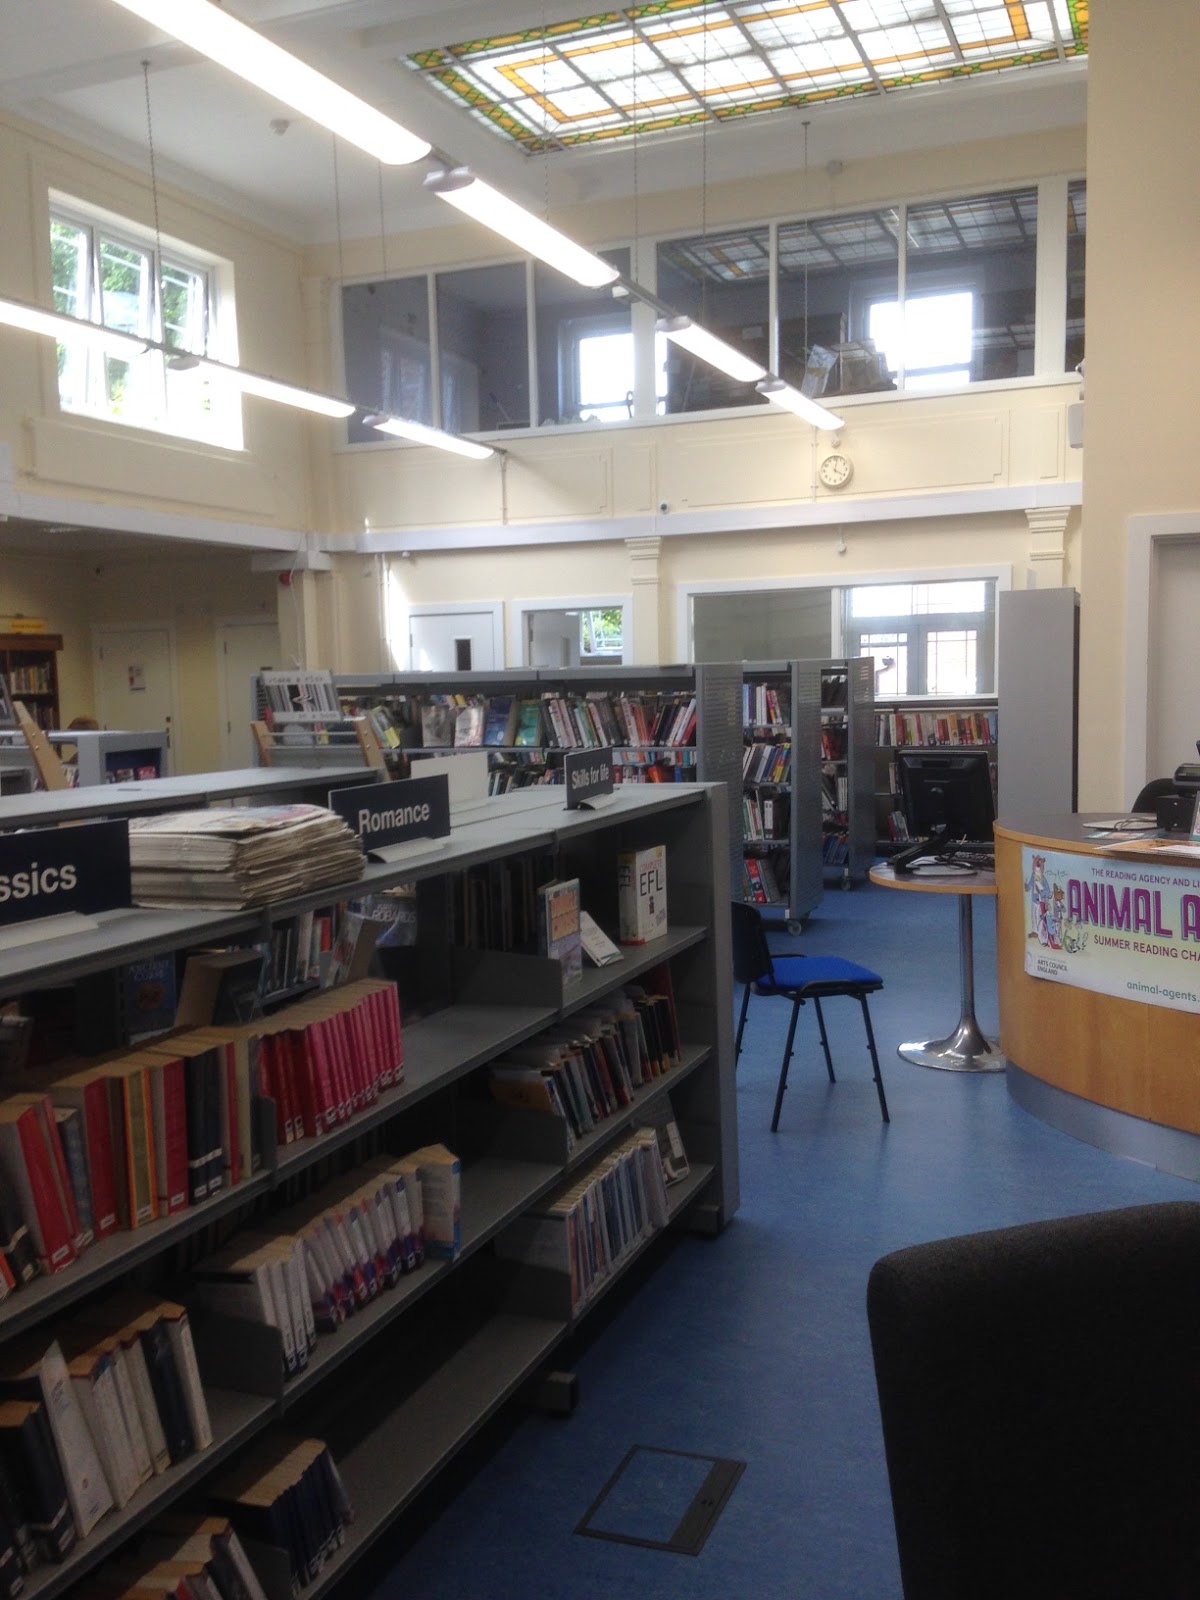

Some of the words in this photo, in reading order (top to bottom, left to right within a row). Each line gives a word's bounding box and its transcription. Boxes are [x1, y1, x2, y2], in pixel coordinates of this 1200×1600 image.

[571, 768, 590, 790] Skills
[590, 766, 599, 784] for
[600, 763, 610, 781] life
[358, 803, 430, 835] Romance
[639, 869, 664, 897] EFL
[1091, 867, 1104, 877] THE
[1105, 869, 1137, 881] READING
[1138, 874, 1171, 885] AGENCY
[1172, 878, 1190, 887] AND
[1067, 879, 1173, 938] ANIMAL
[1093, 934, 1131, 950] SUMMER
[1133, 941, 1178, 959] READING
[1037, 959, 1049, 967] ARTS
[1048, 961, 1068, 971] COUNCIL
[1037, 965, 1058, 975] ENGLAND
